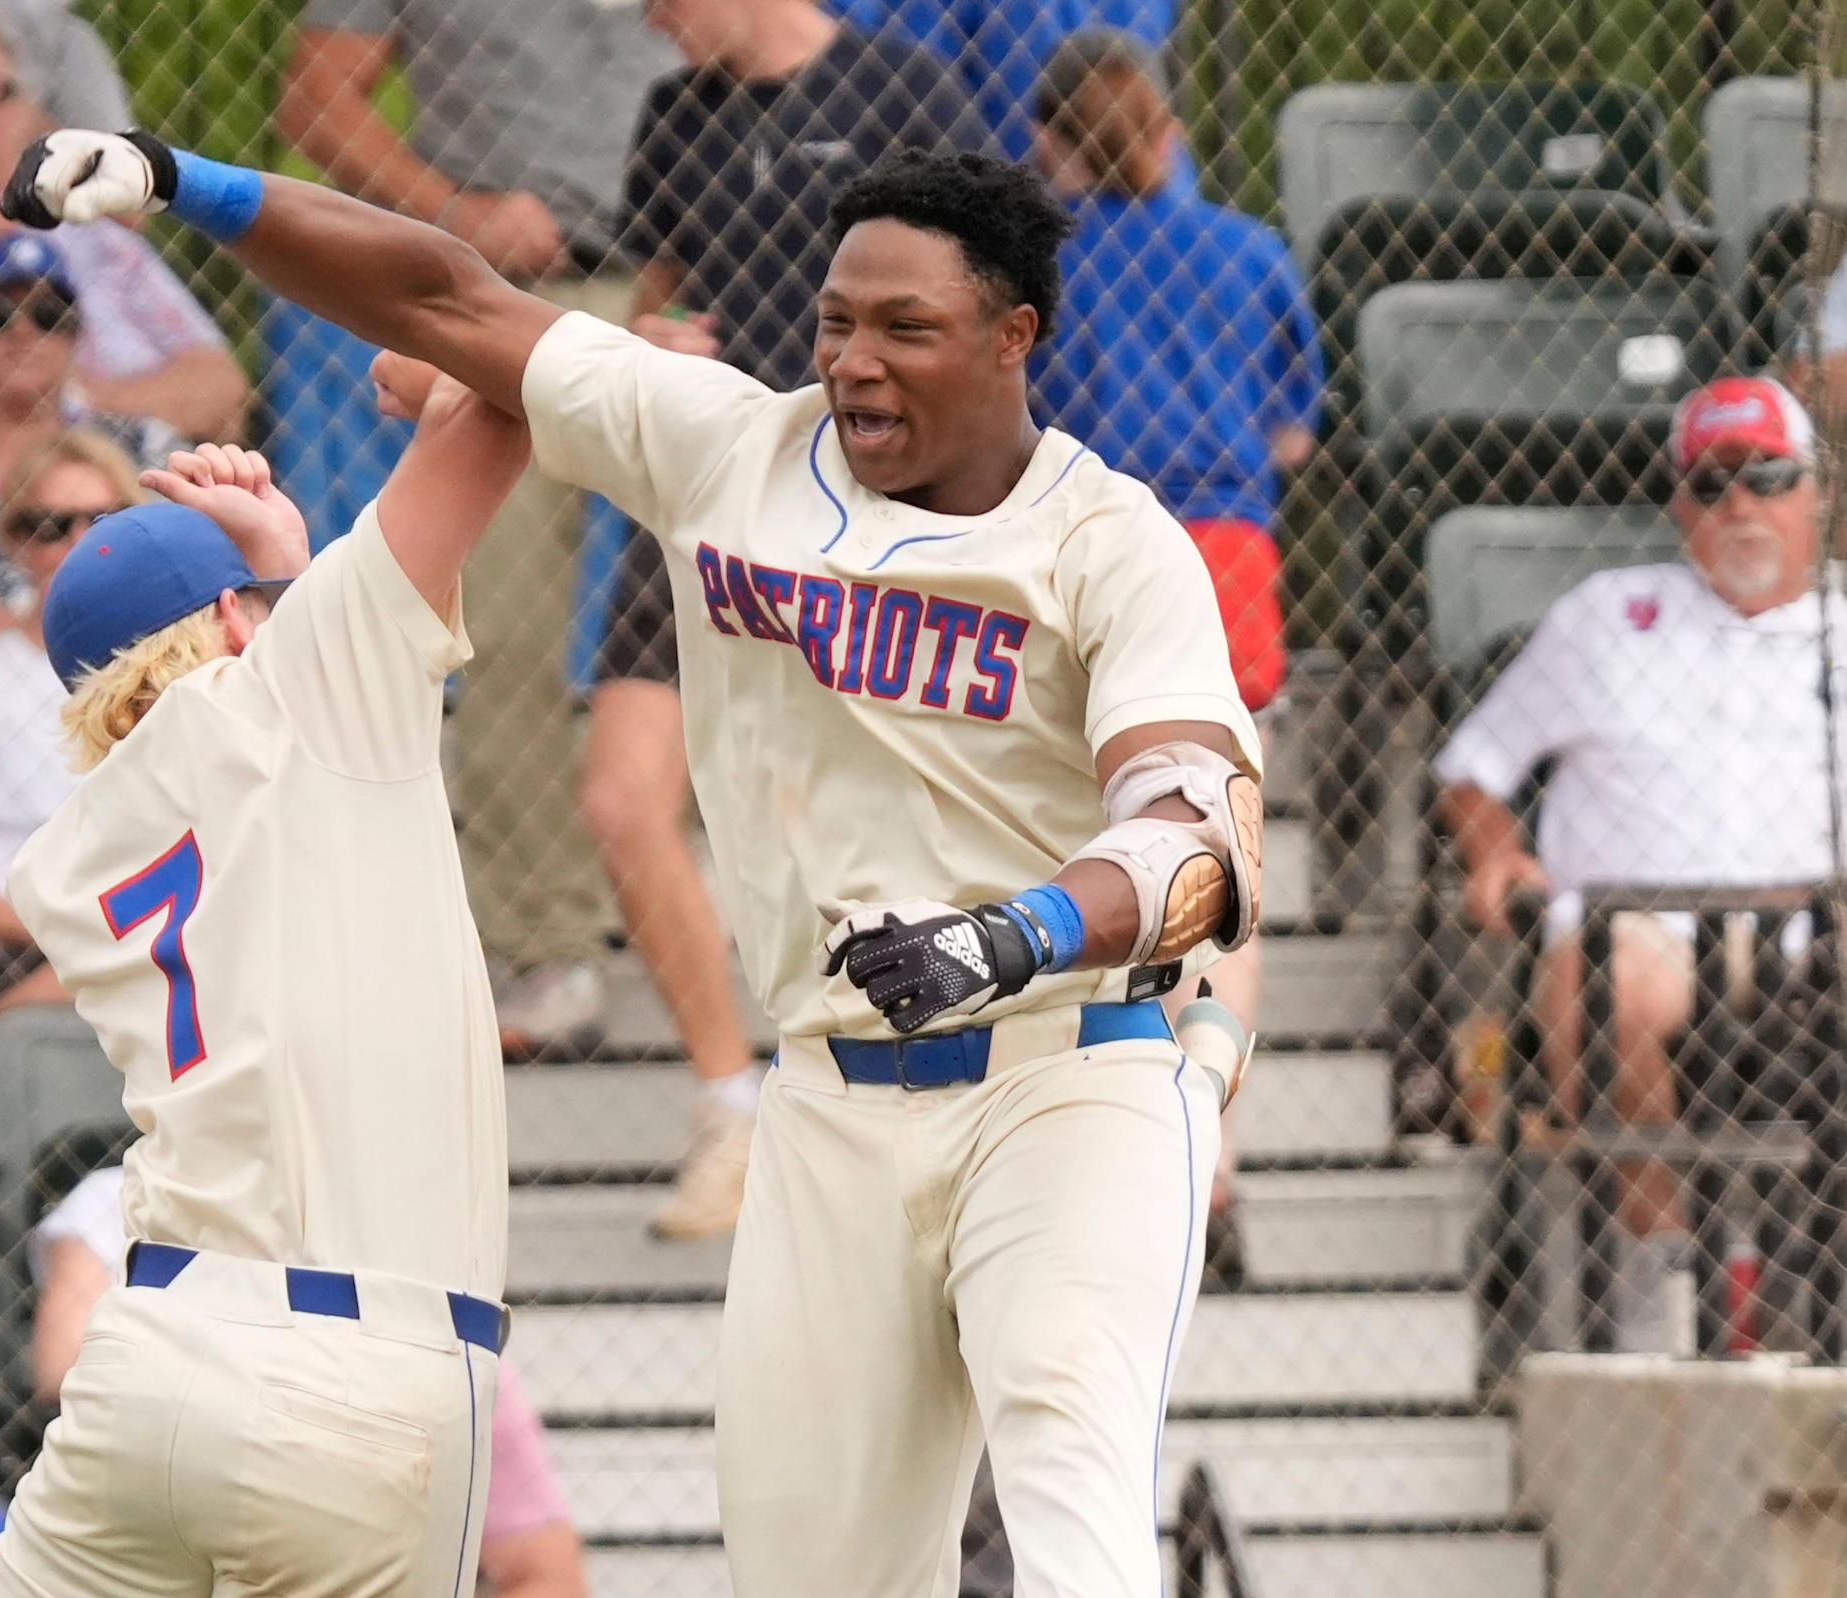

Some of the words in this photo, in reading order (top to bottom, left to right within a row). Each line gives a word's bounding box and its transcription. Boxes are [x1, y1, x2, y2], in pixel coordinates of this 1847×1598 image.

[695, 540, 1030, 721] PATRIOTS
[98, 827, 207, 1083] 7
[933, 933, 990, 979] adidas
